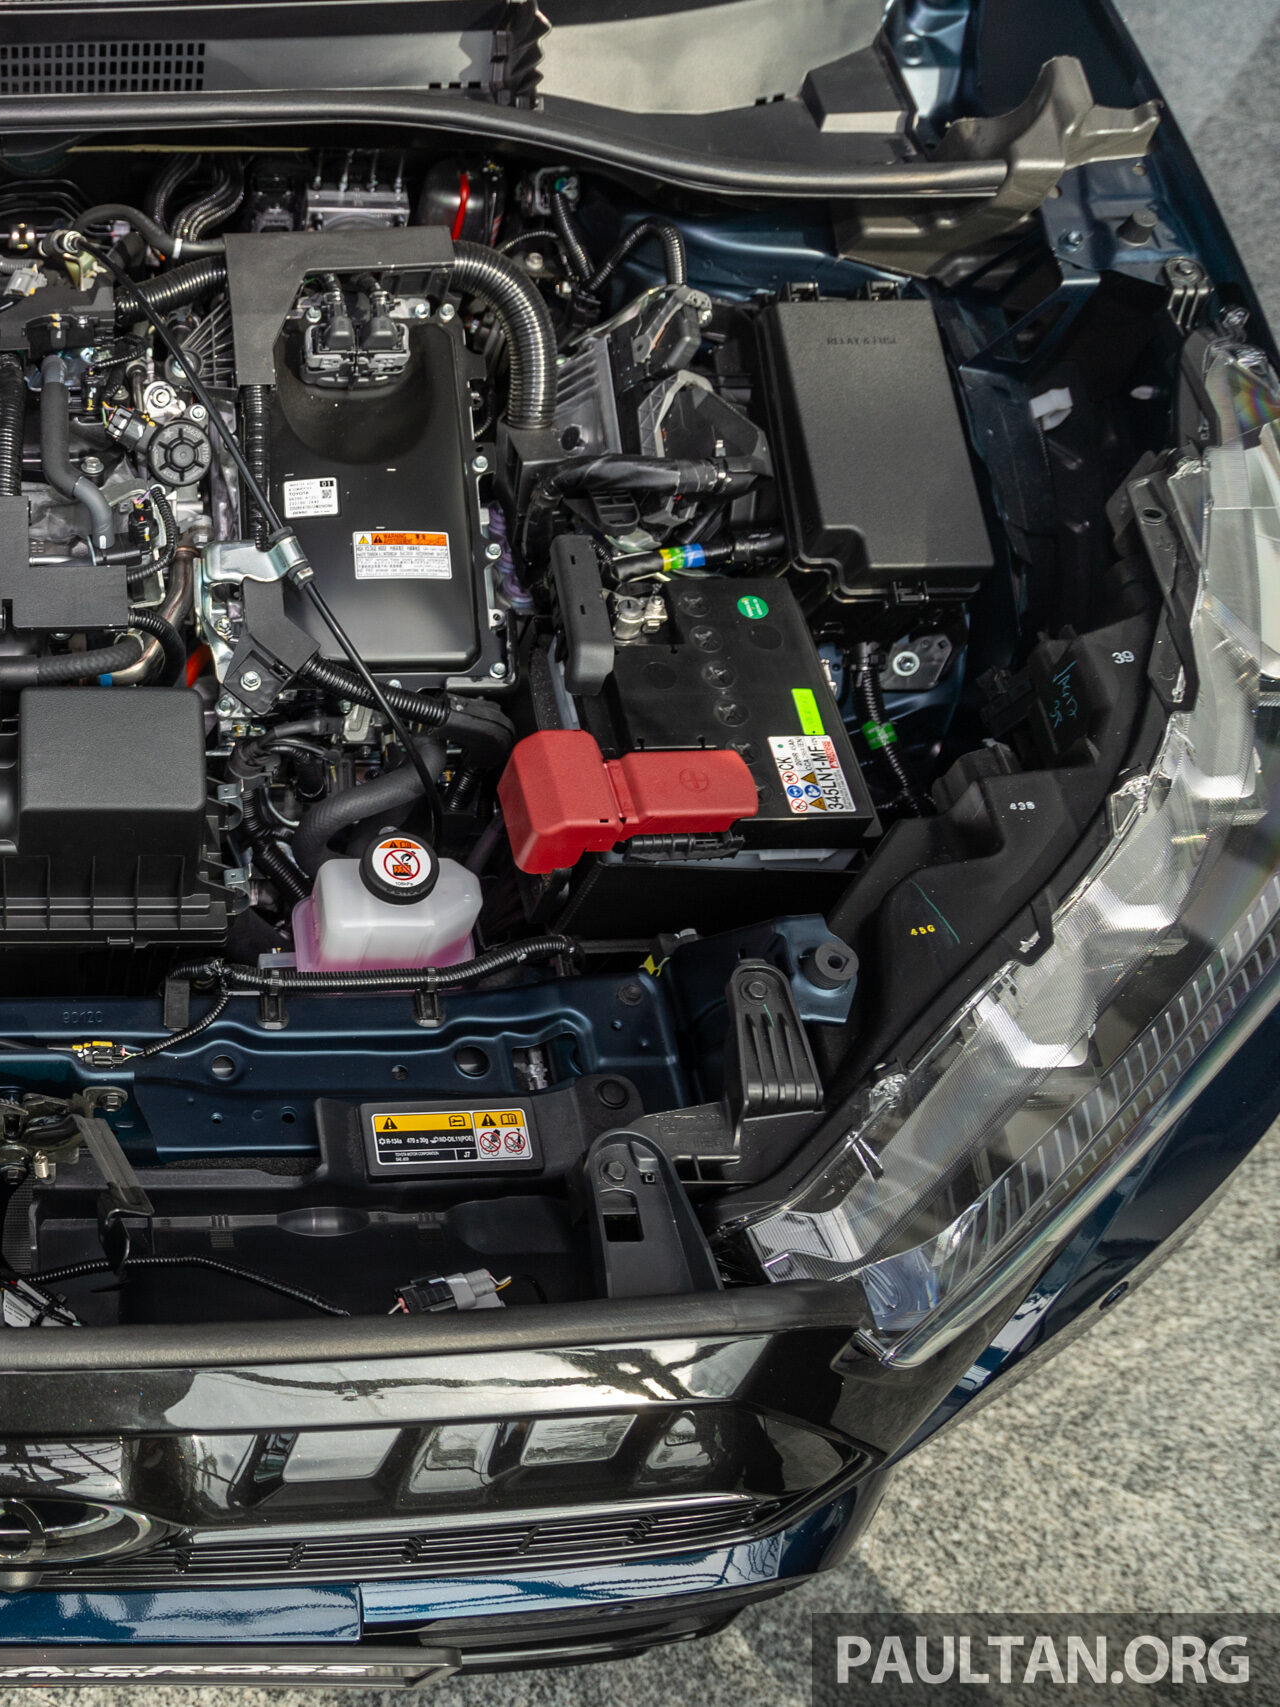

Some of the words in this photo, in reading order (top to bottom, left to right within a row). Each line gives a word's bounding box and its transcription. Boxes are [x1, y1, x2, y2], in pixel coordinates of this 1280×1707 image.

[1112, 651, 1135, 664] 39
[776, 757, 794, 770] CK
[808, 746, 844, 809] 345LN1-MF
[89, 1665, 374, 1674] CROSS
